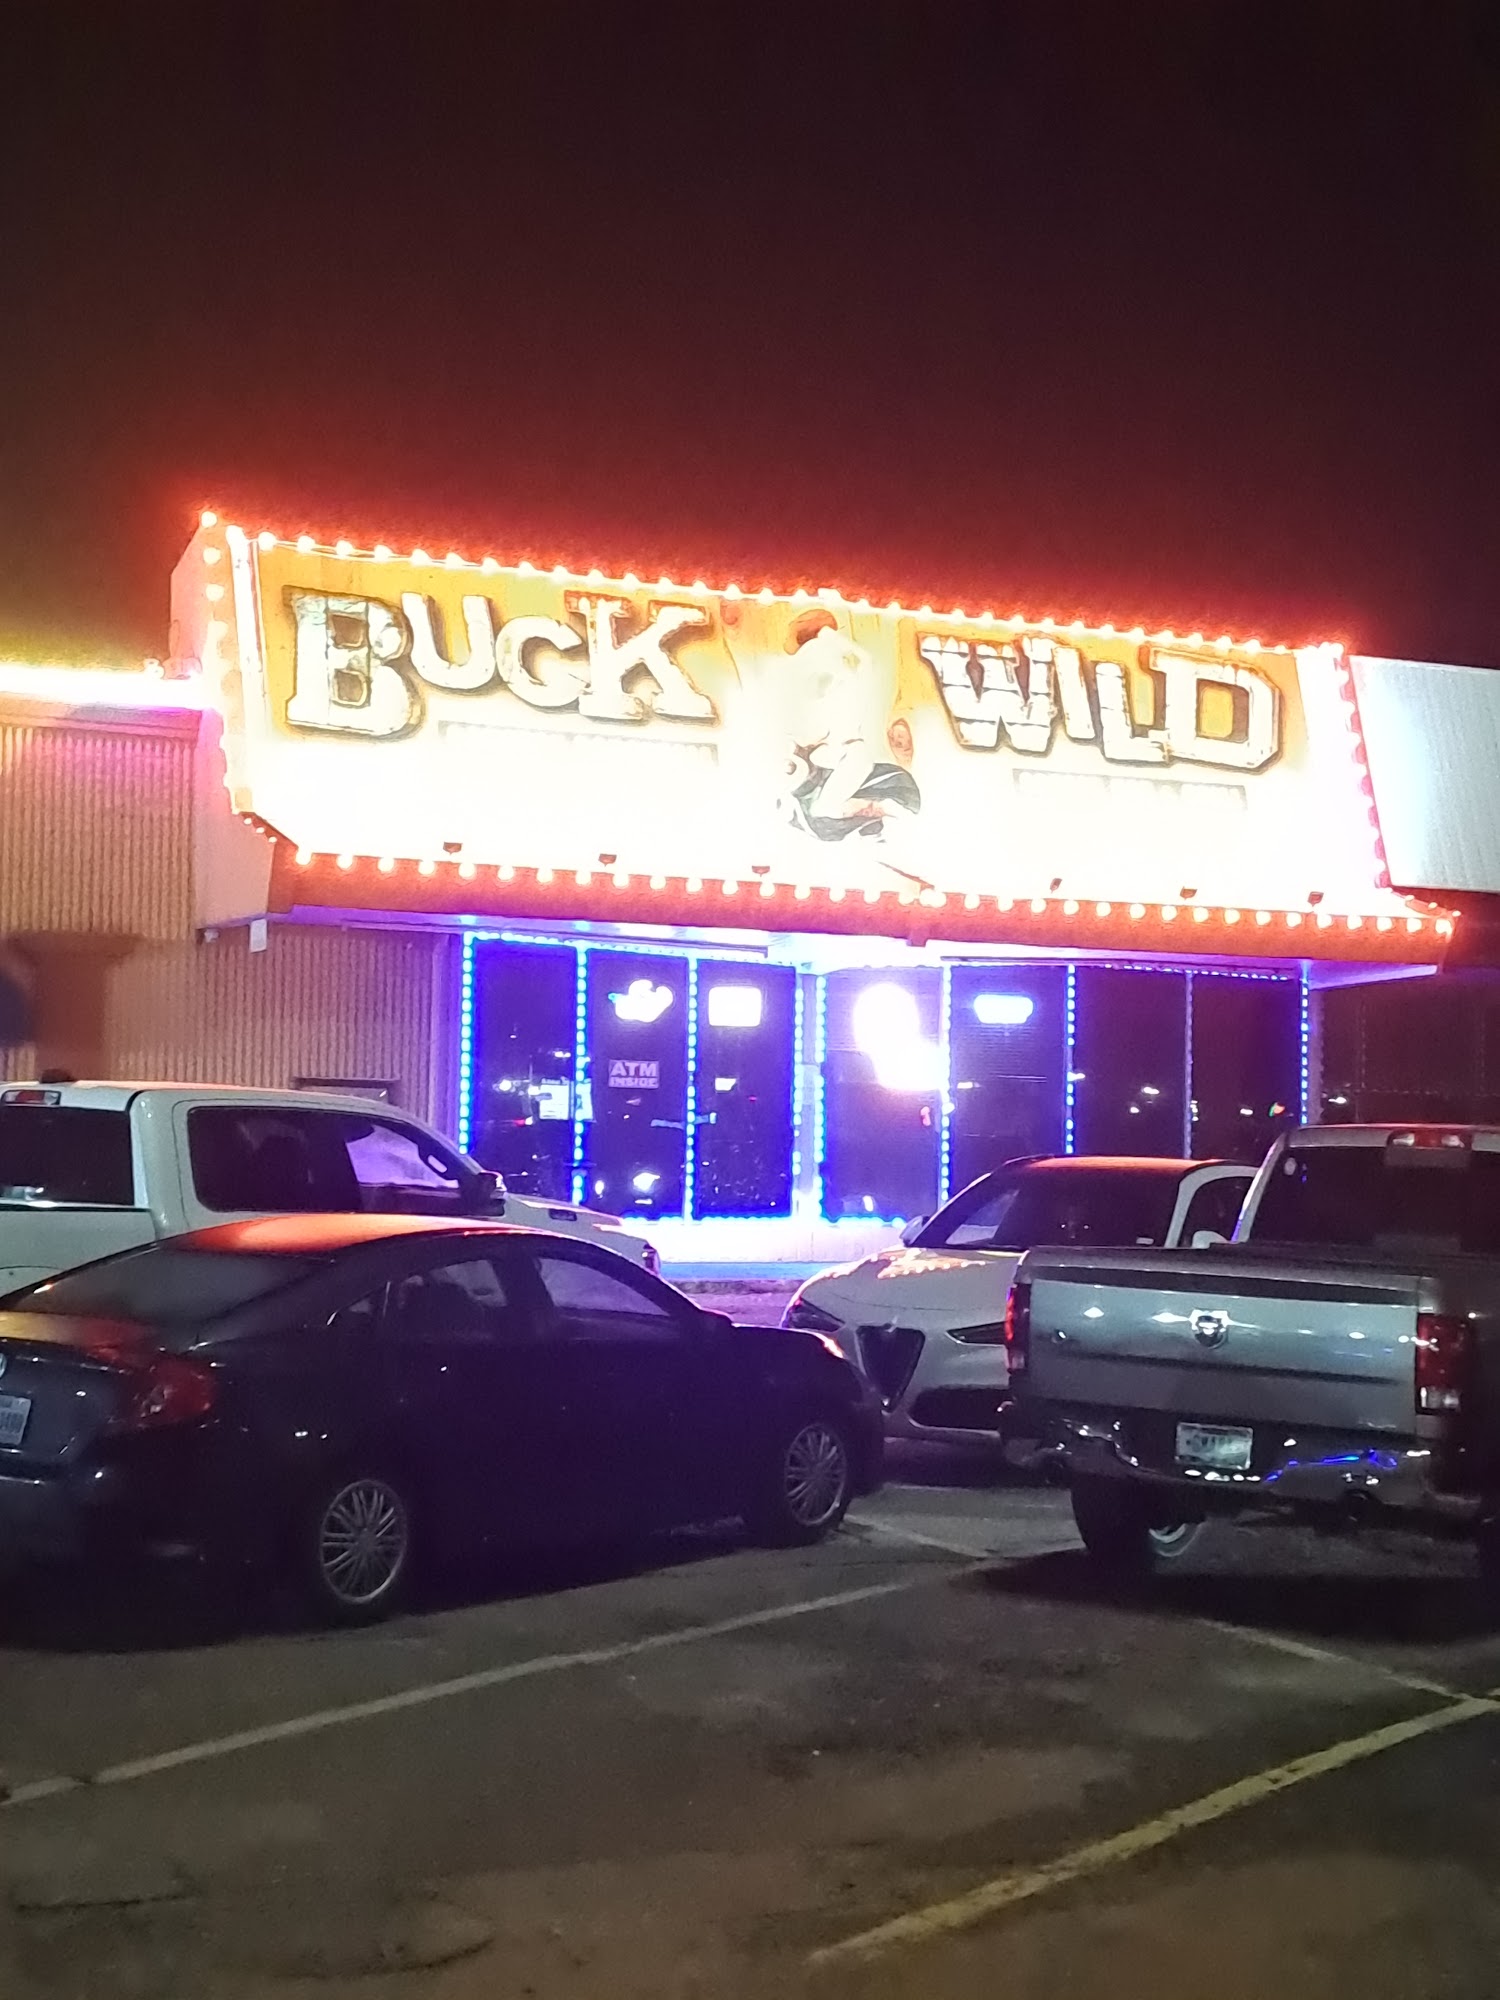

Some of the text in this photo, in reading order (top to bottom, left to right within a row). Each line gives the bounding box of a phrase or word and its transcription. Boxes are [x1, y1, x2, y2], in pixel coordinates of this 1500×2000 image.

[283, 586, 1283, 773] BUCK WILD
[610, 1061, 657, 1077] ATM
